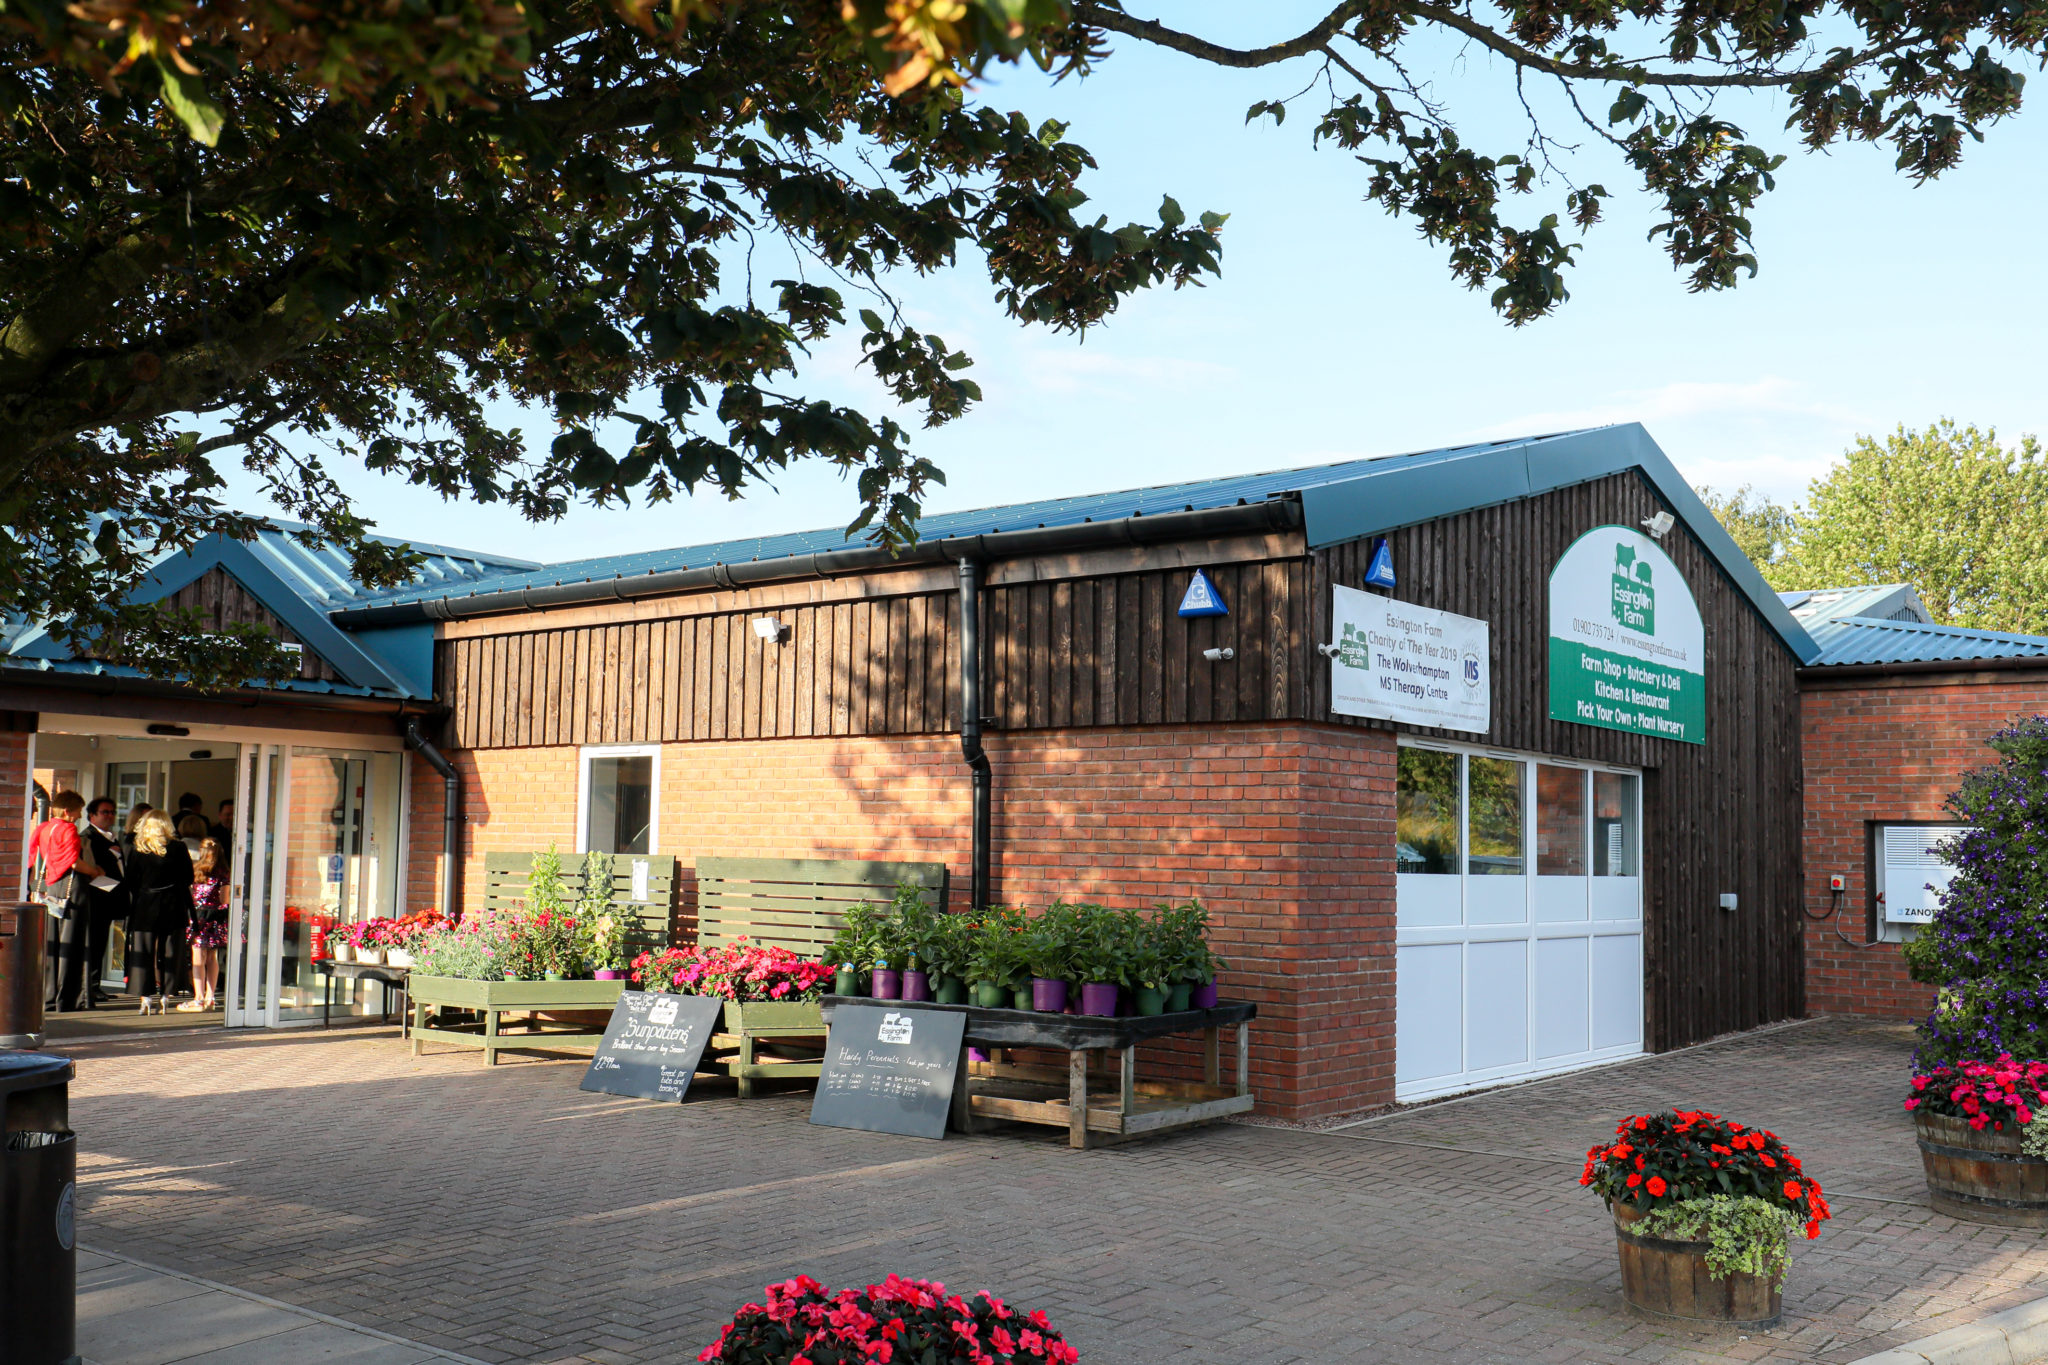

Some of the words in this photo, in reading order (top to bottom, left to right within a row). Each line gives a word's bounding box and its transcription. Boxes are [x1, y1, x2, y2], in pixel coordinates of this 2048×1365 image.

[1184, 600, 1213, 609] Chubb
[1614, 582, 1652, 610] Essington
[1386, 613, 1422, 635] Essington
[1424, 622, 1443, 638] Farm
[1623, 605, 1645, 627] Farm
[1368, 630, 1396, 650] Charity
[1399, 637, 1406, 650] of
[1407, 639, 1422, 654] The
[1424, 642, 1438, 657] Year
[1440, 646, 1458, 661] 2019
[1573, 618, 1592, 636] 01902
[1603, 626, 1614, 642] 724
[1620, 634, 1687, 662] www.essingtonfarm.co.uk
[1377, 653, 1391, 669] The
[1392, 658, 1450, 681] Wolverhampton
[1464, 659, 1479, 681] MS
[1581, 653, 1602, 673] Farm
[1603, 658, 1621, 680] Shop
[1627, 664, 1660, 690] Butchery
[1661, 673, 1666, 687] &
[1667, 675, 1681, 691] Deli
[1380, 676, 1392, 691] MS
[1393, 678, 1425, 699] Therapy
[1426, 684, 1448, 700] Centre
[1595, 680, 1624, 702] Kitchen
[1625, 687, 1630, 702] &
[1631, 688, 1670, 710] Restaurant
[1577, 700, 1595, 719] Pick
[1596, 704, 1613, 722] Your
[1614, 708, 1631, 726] Own
[1638, 712, 1656, 730] Plant
[1657, 716, 1685, 738] Nursery
[881, 1027, 910, 1036] Essington
[839, 1046, 861, 1065] Hardy
